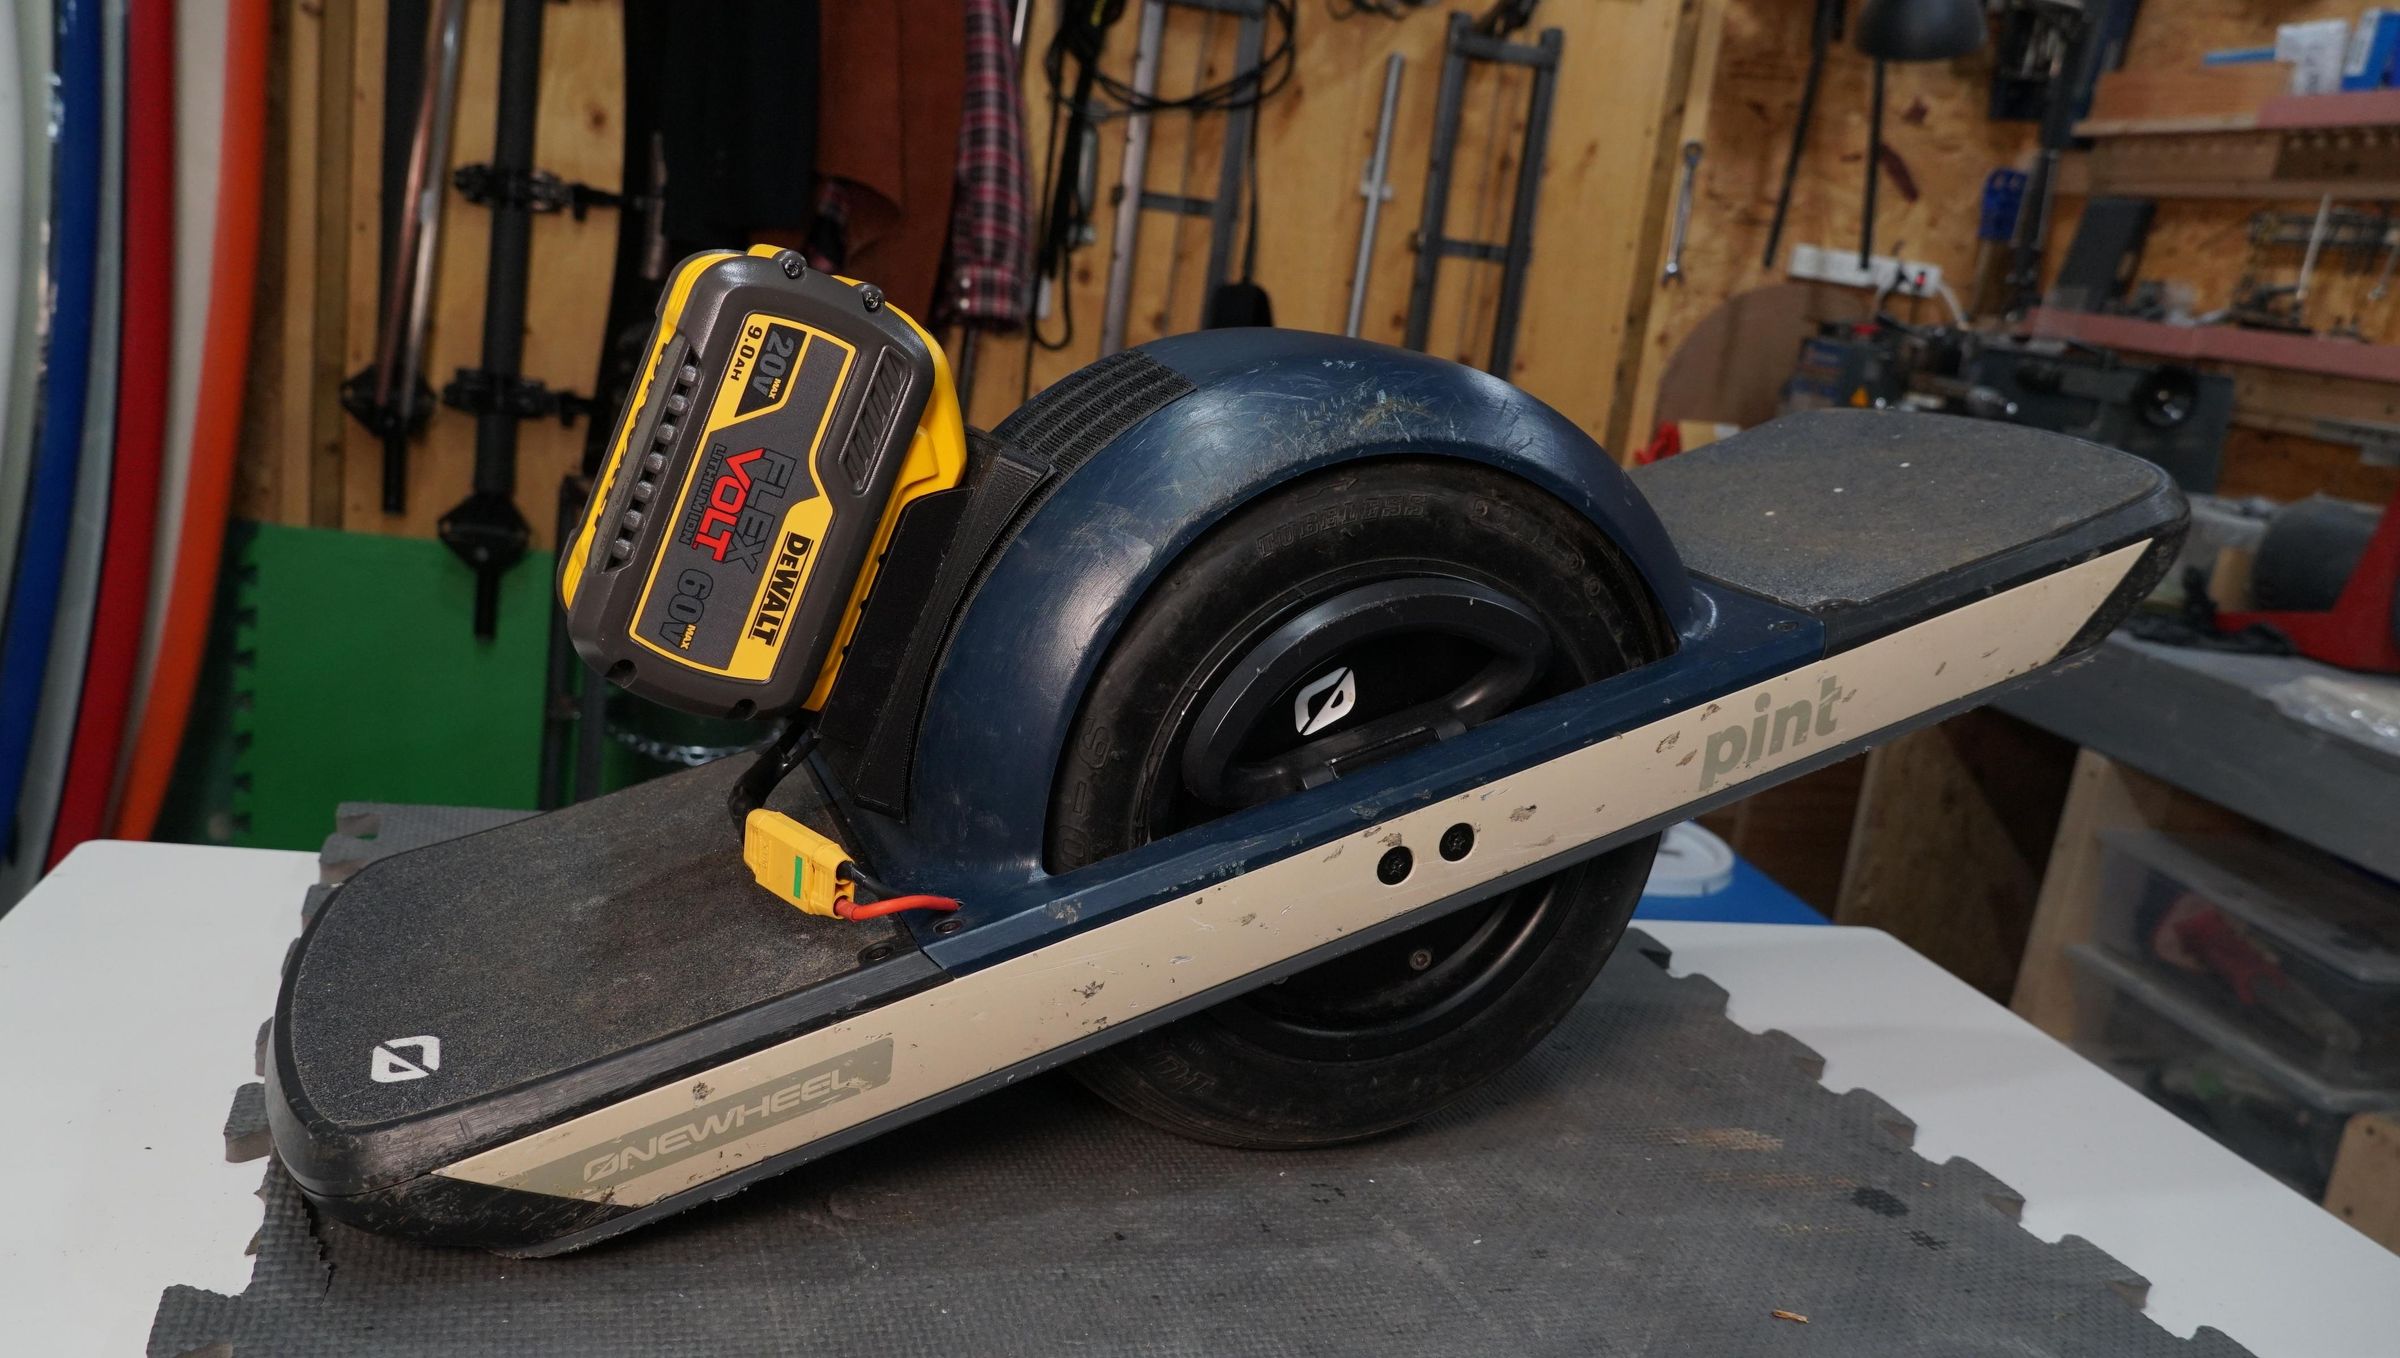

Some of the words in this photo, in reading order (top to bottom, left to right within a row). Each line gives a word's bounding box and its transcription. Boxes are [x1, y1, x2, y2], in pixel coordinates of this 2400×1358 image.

[731, 325, 763, 382] 9.0AH
[752, 331, 795, 396] 20V
[769, 378, 782, 399] MAX
[689, 443, 727, 514] LITHIUM
[695, 447, 765, 563] VOLT
[723, 448, 797, 574] FLEX
[677, 511, 701, 546] ION
[1256, 495, 1427, 559] TUBELESS
[659, 568, 714, 648] 60V
[751, 531, 813, 647] DEWALT
[679, 623, 698, 651] MAX
[1699, 675, 1843, 792] pint
